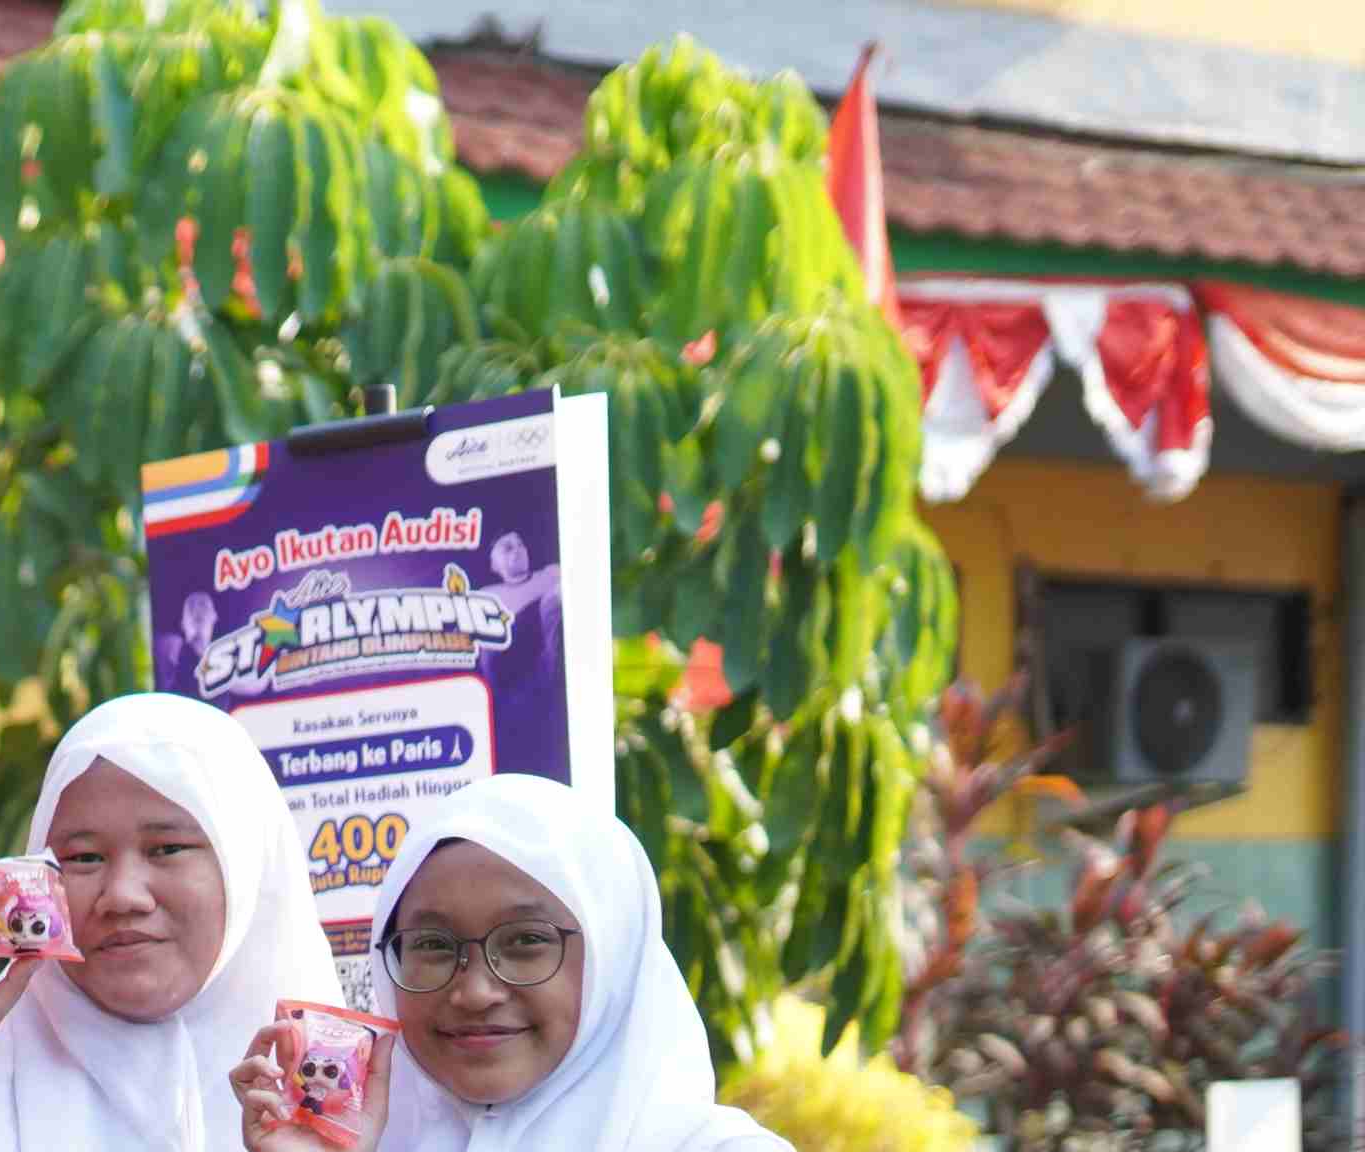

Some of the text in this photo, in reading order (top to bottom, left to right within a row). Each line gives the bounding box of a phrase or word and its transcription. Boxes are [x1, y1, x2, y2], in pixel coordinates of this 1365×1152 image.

[216, 509, 480, 588] Ayo Ikutan Audisi
[358, 707, 418, 725] Serunya
[279, 736, 443, 776] Terbang ke Paris
[312, 788, 350, 809] Total
[355, 783, 410, 805] Hadiah
[309, 813, 409, 866] 400
